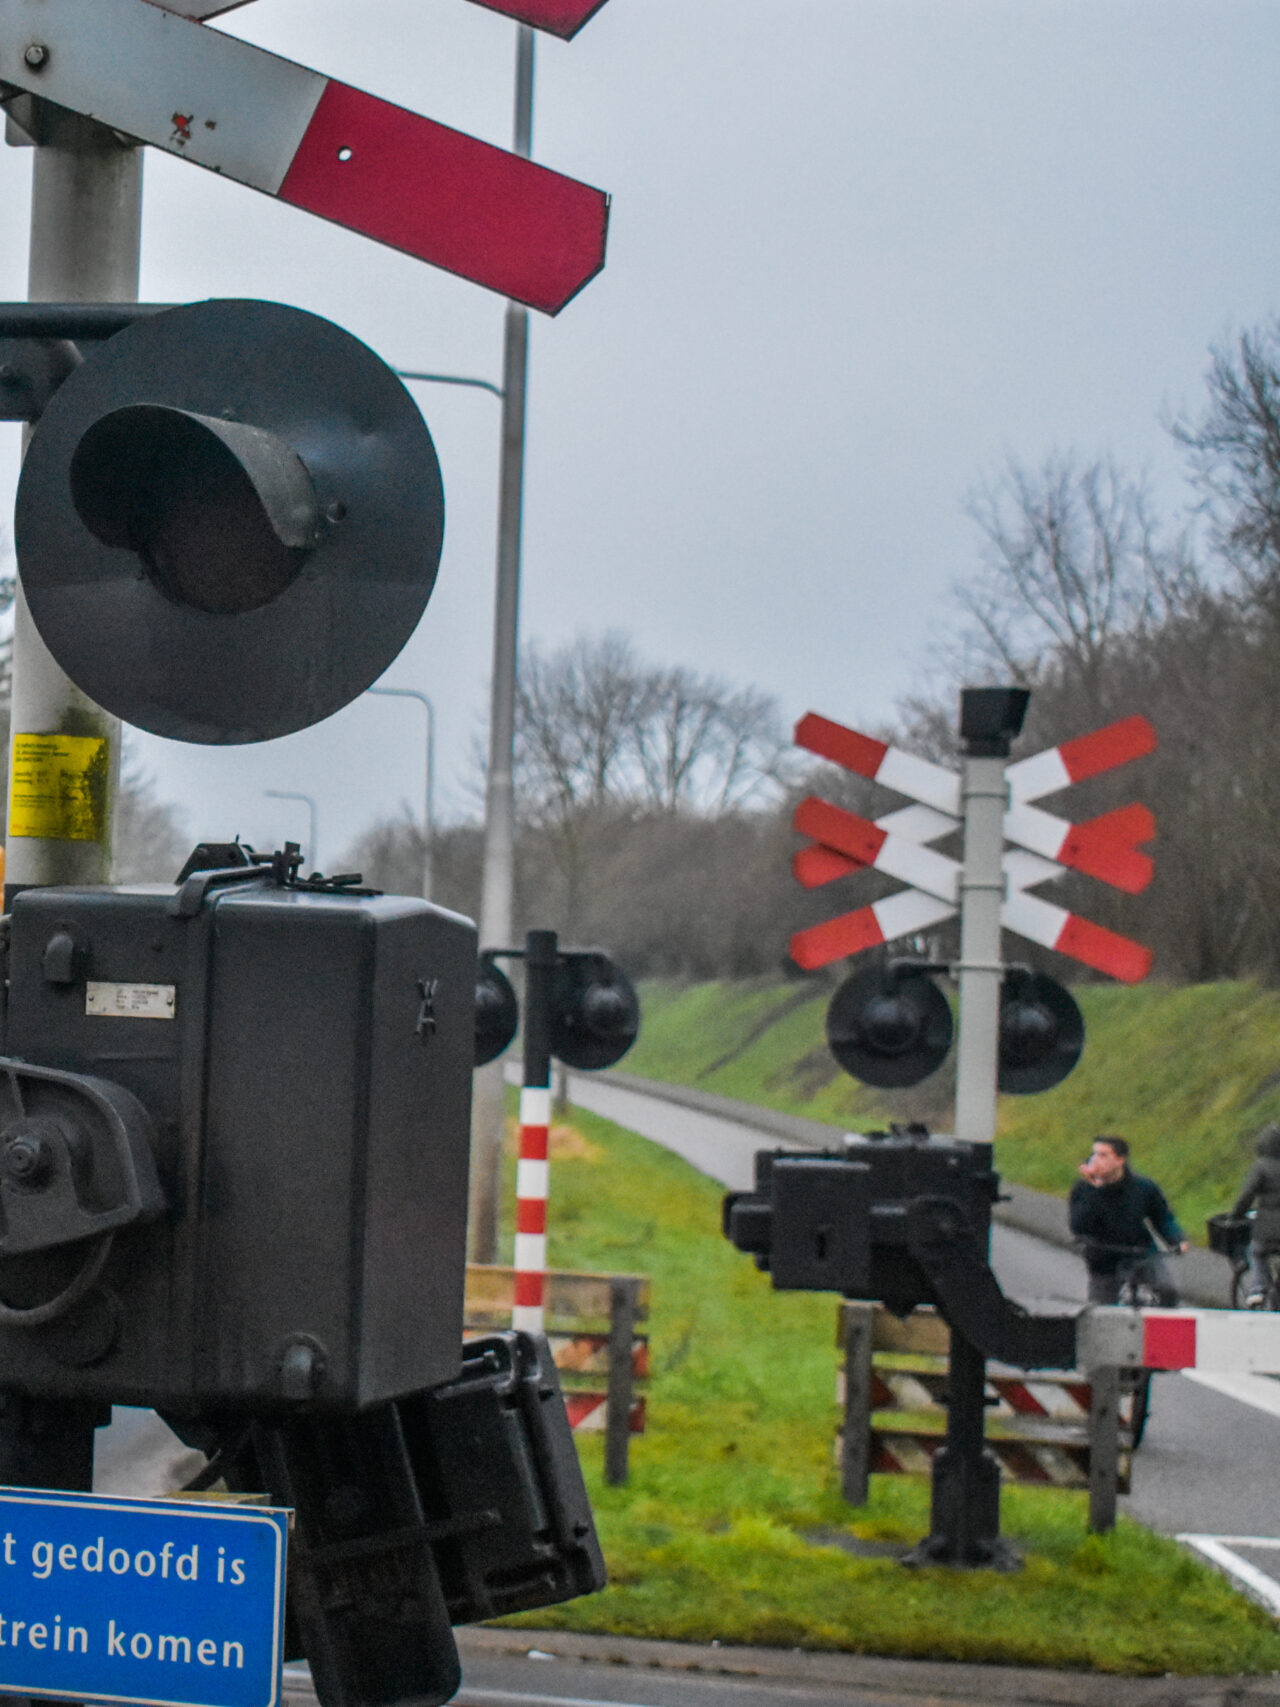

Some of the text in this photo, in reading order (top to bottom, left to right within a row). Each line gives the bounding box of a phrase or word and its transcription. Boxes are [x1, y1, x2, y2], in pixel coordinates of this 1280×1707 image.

[32, 1537, 199, 1581] gedoofd
[217, 1547, 245, 1586] is
[108, 1620, 244, 1669] komen
